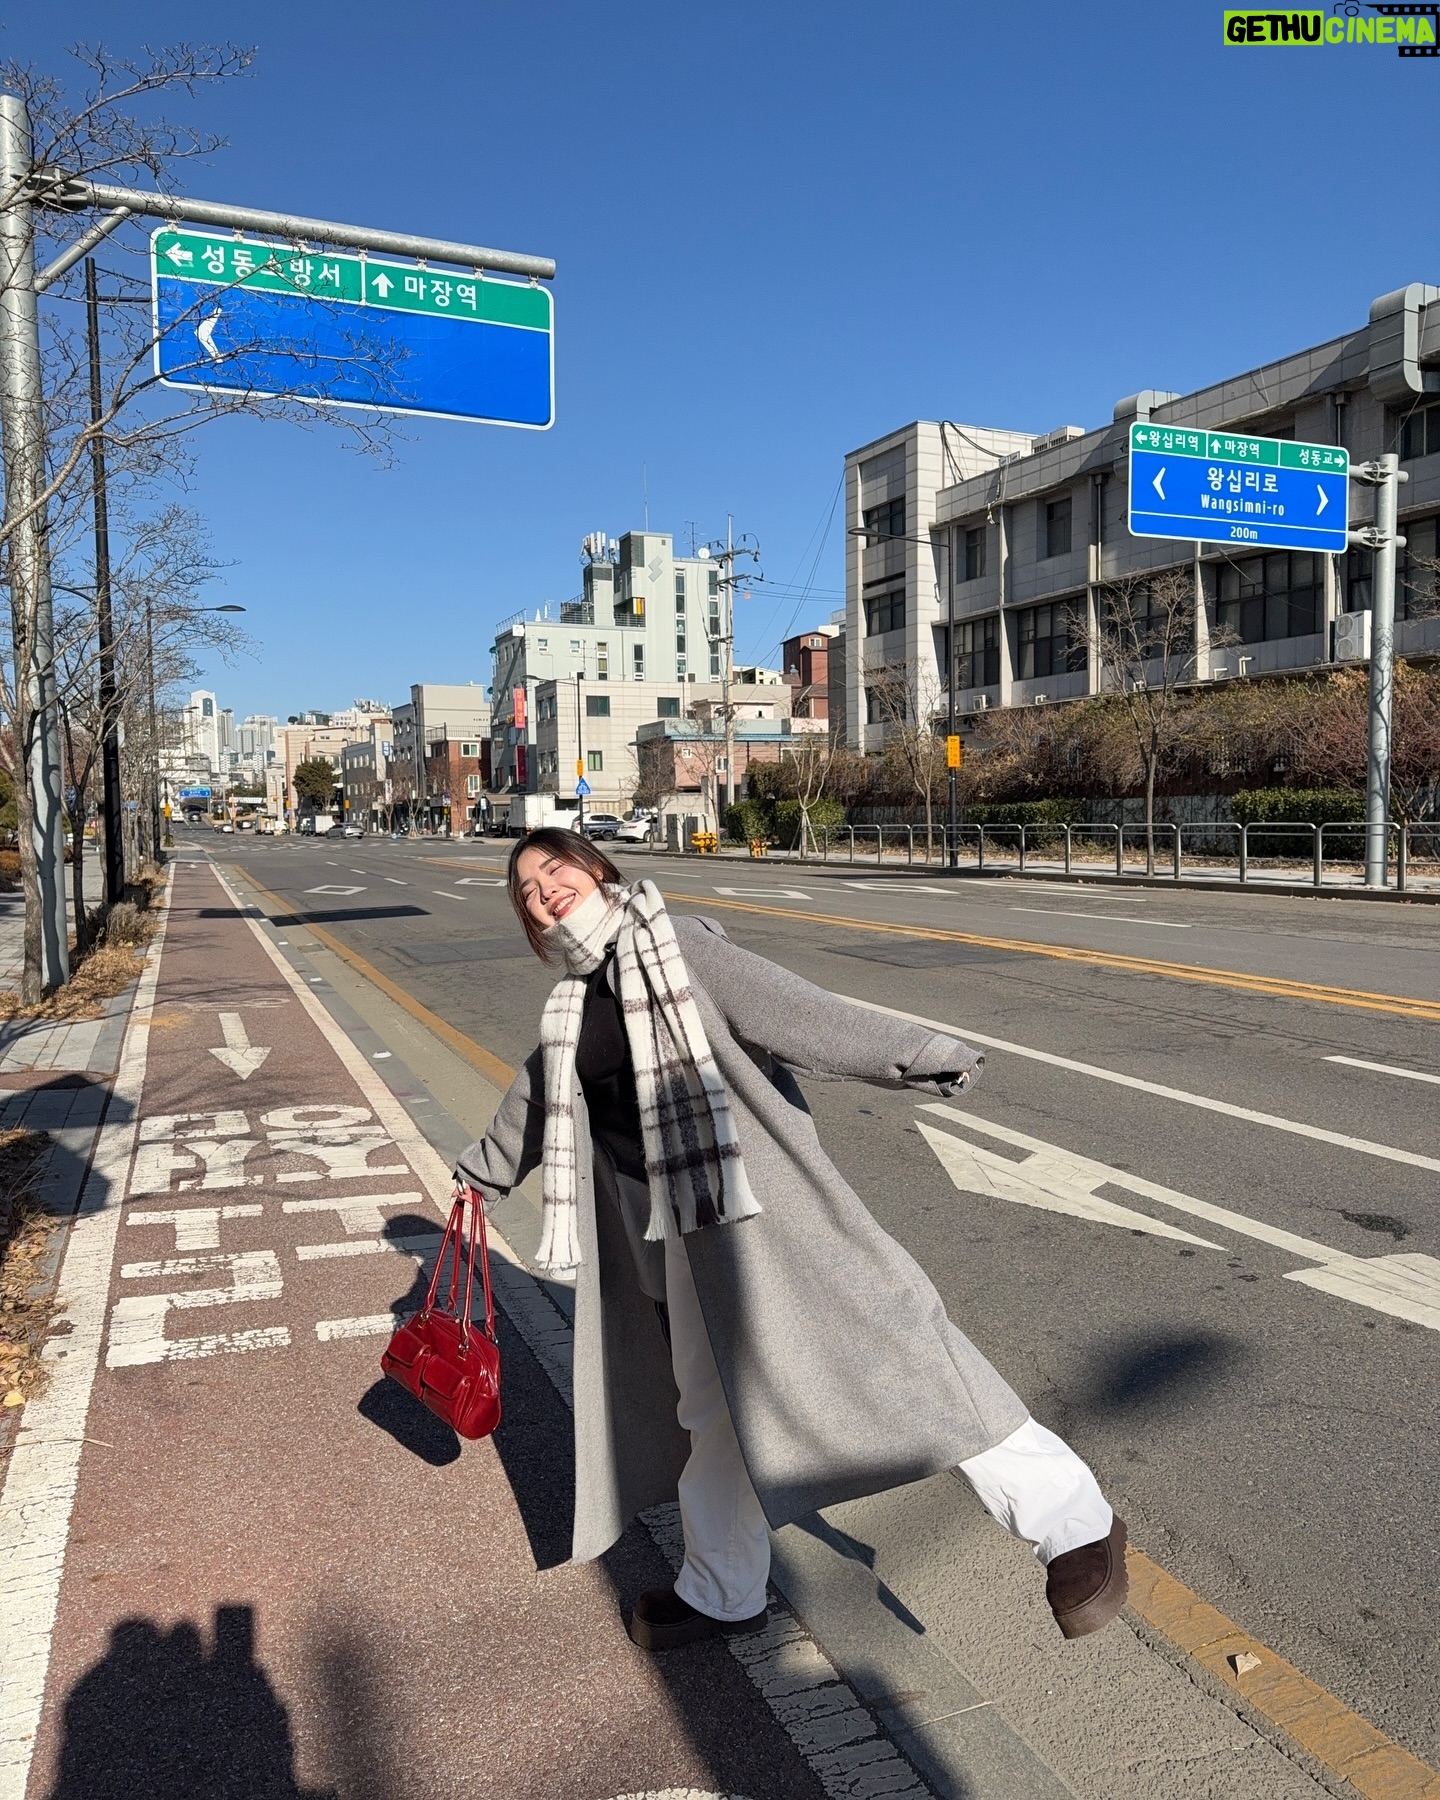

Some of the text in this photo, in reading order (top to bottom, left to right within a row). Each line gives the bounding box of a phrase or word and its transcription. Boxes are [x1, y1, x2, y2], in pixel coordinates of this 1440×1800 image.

[404, 276, 477, 311] 마장역
[1148, 431, 1199, 452] 왕십리역
[1224, 439, 1260, 459] 마장역
[1299, 448, 1334, 467] 성동교
[1206, 467, 1279, 493] 왕십리로
[1200, 493, 1285, 516] Wangsimni-ro
[1230, 526, 1258, 540] 200m
